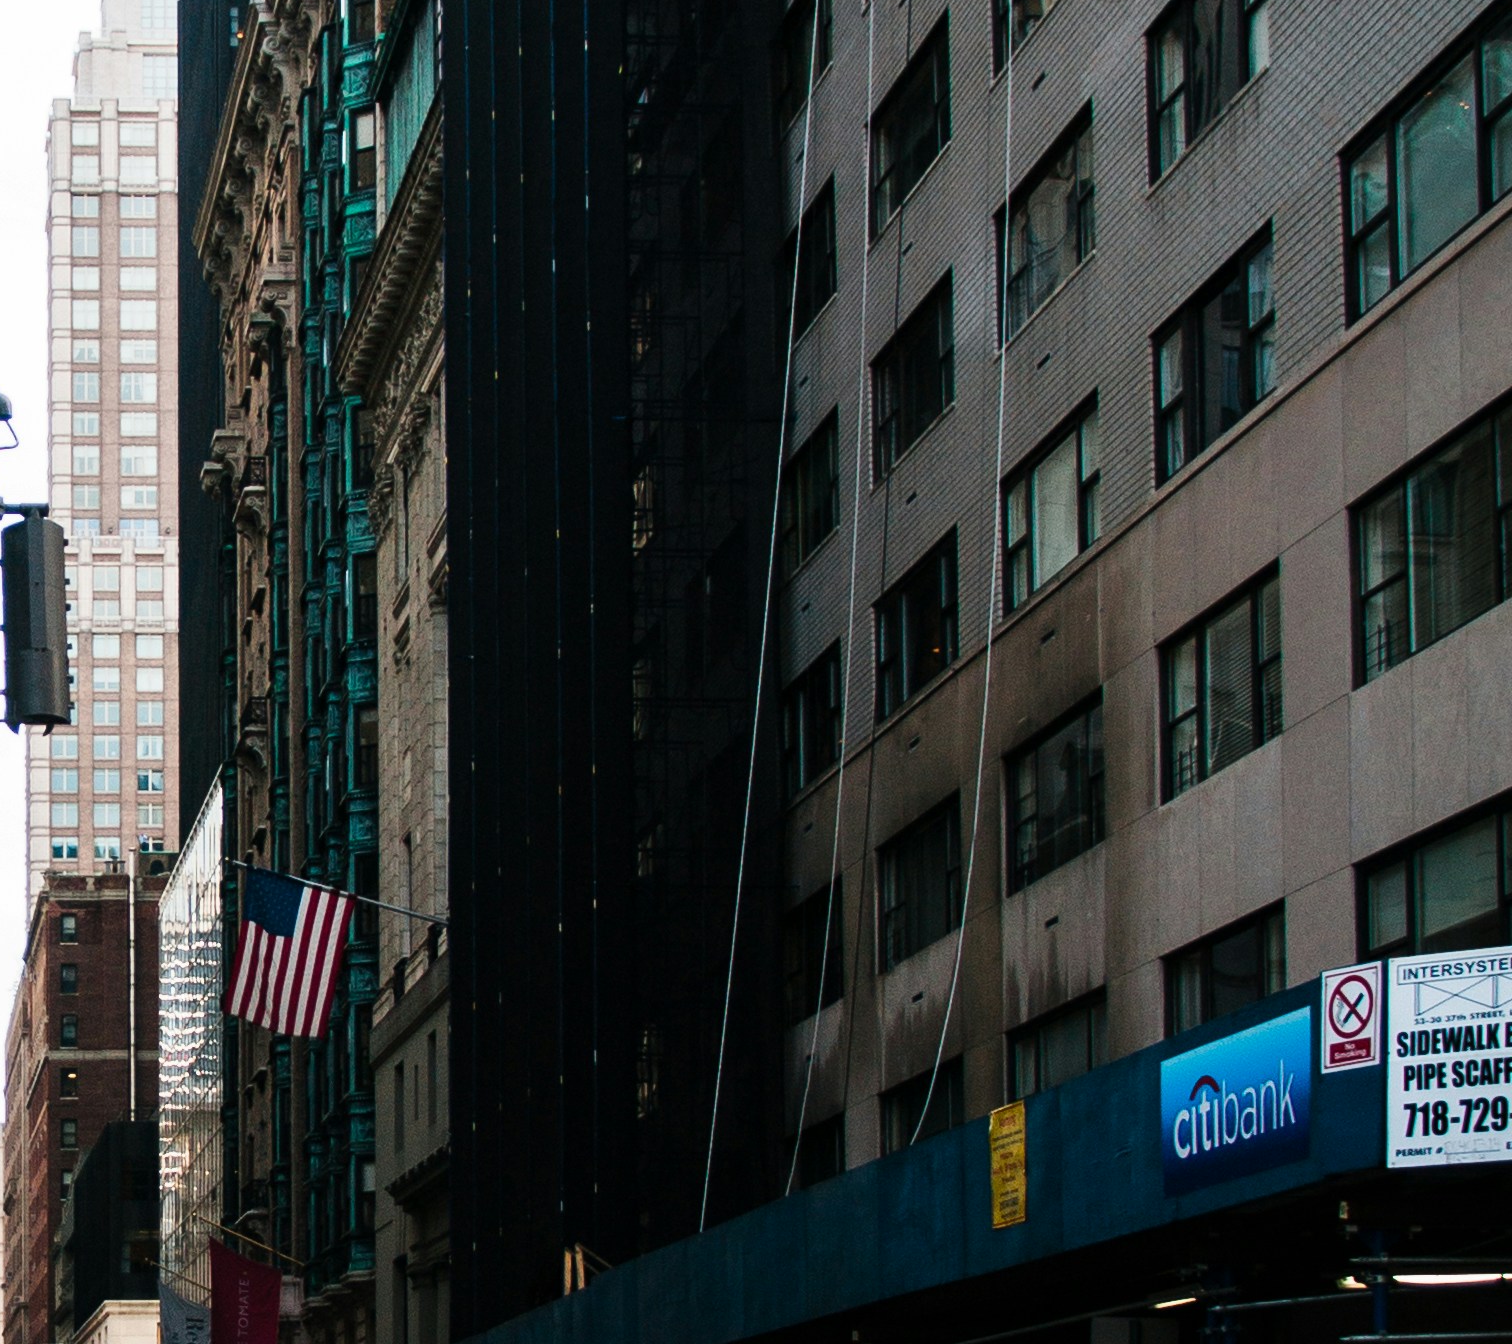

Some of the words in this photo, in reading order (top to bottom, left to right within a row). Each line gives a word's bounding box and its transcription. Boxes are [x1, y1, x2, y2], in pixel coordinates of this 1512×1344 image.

[1402, 956, 1512, 981] INTERSYSTE
[1396, 1022, 1500, 1058] SIDEWALK
[1403, 1062, 1448, 1092] PIPE
[1173, 1058, 1296, 1159] citibank
[1403, 1095, 1512, 1138] 718-729
[1395, 1146, 1433, 1158] PERMIT
[238, 1278, 250, 1338] TOMATE
